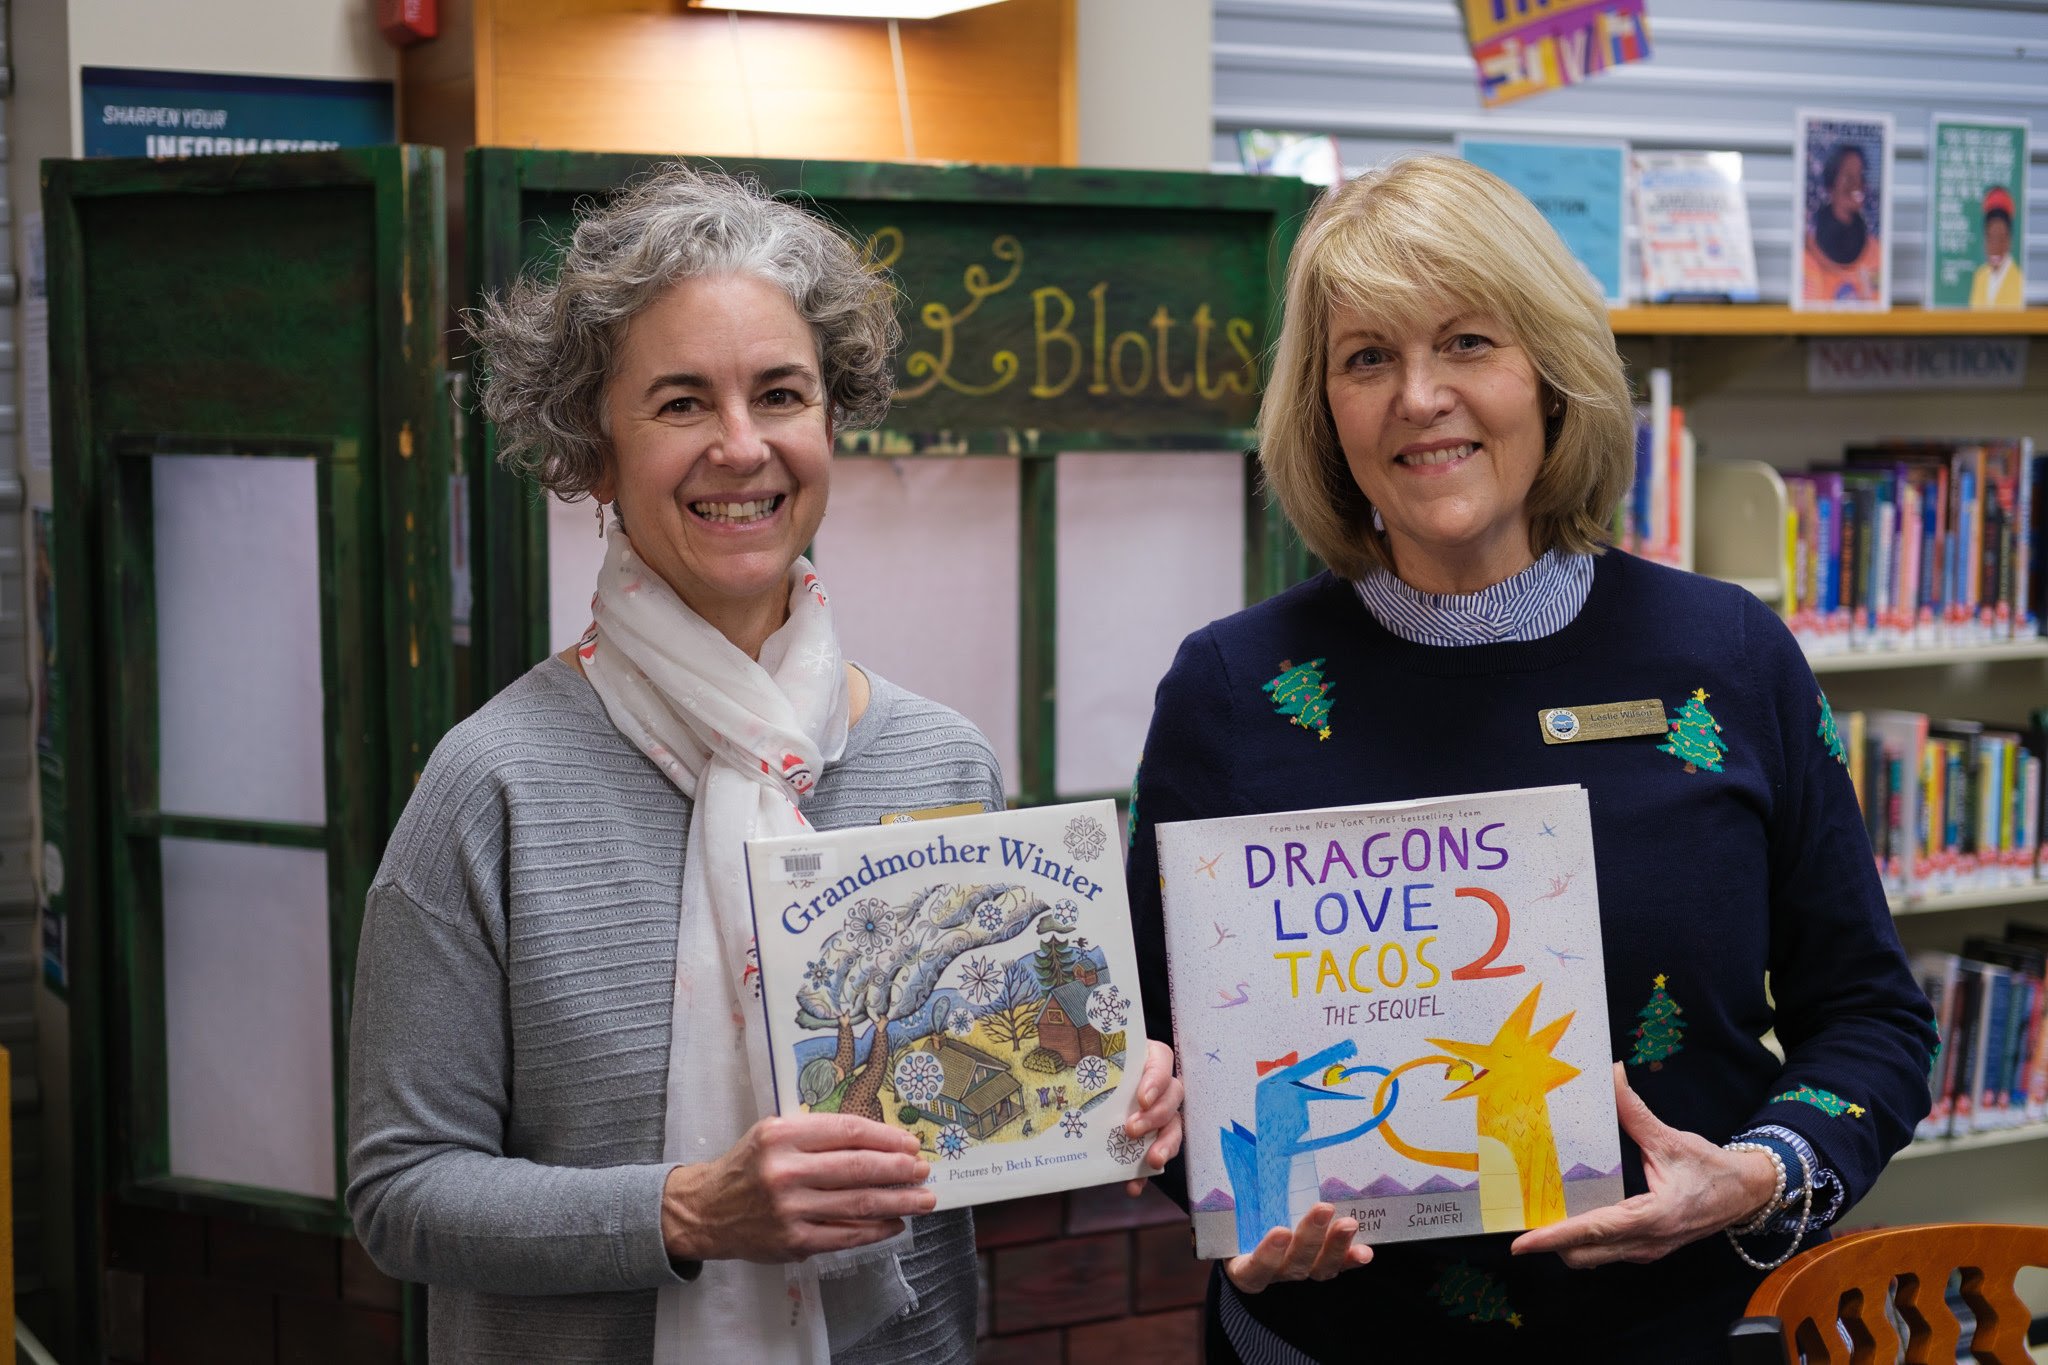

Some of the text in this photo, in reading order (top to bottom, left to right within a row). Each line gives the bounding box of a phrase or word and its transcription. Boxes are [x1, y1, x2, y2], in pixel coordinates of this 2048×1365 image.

[102, 105, 227, 130] SHARPEN YOUR
[146, 135, 340, 159] INFORM
[1029, 282, 1258, 399] Blotts
[1590, 709, 1653, 722] Leslie Wilson
[1295, 823, 1310, 831] the
[1401, 812, 1454, 823] bestselling
[1459, 810, 1482, 818] team
[1244, 822, 1509, 889] DRAGONS
[781, 835, 1104, 935] Grandmother Winter
[1273, 883, 1526, 981] LOVE 2
[1273, 936, 1441, 998] TACOS
[1322, 995, 1446, 1026] THE SEQUEL
[949, 1167, 989, 1181] Pictures
[992, 1163, 1004, 1176] by
[1006, 1157, 1031, 1171] Beth
[1034, 1152, 1088, 1167] Krommes
[1350, 1201, 1461, 1220] ADAM DANIEL
[1358, 1212, 1463, 1232] BIN SALMIERI
